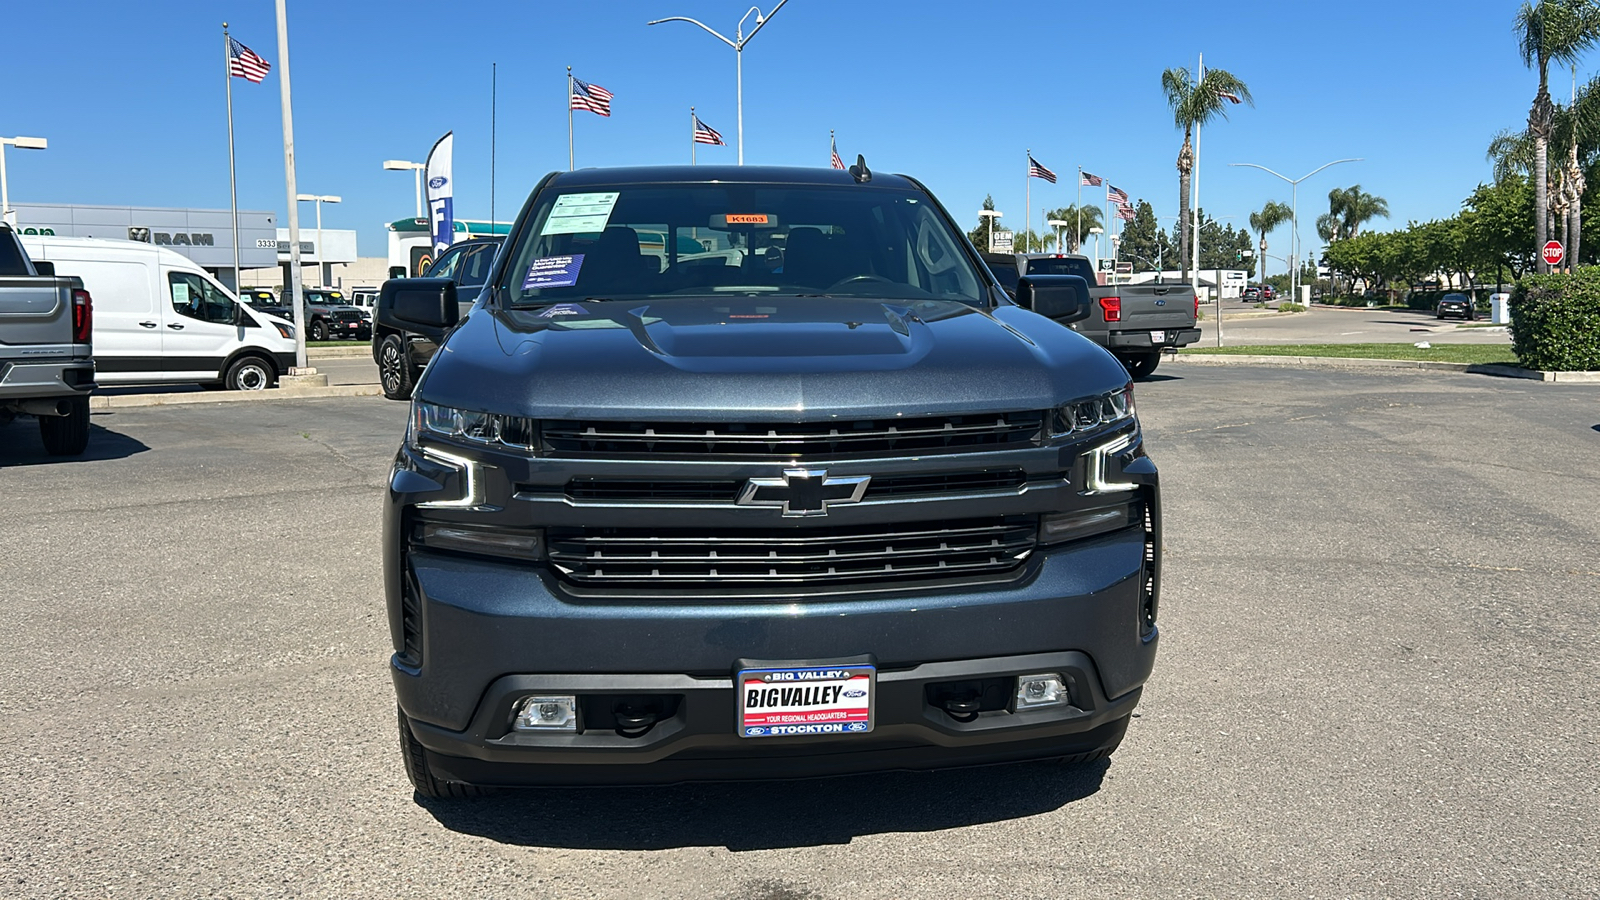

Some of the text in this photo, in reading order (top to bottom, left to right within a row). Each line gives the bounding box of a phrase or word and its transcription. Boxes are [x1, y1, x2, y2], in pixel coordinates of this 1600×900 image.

[153, 232, 214, 246] RAM
[257, 239, 276, 248] 3333
[1544, 247, 1562, 257] STOP
[772, 670, 843, 681] BIG VALLEY
[746, 685, 865, 708] BIGVALLEY Ford
[766, 712, 848, 723] YOUR REGIONAL HEADQUARTERS
[770, 724, 843, 735] STOCKTON
